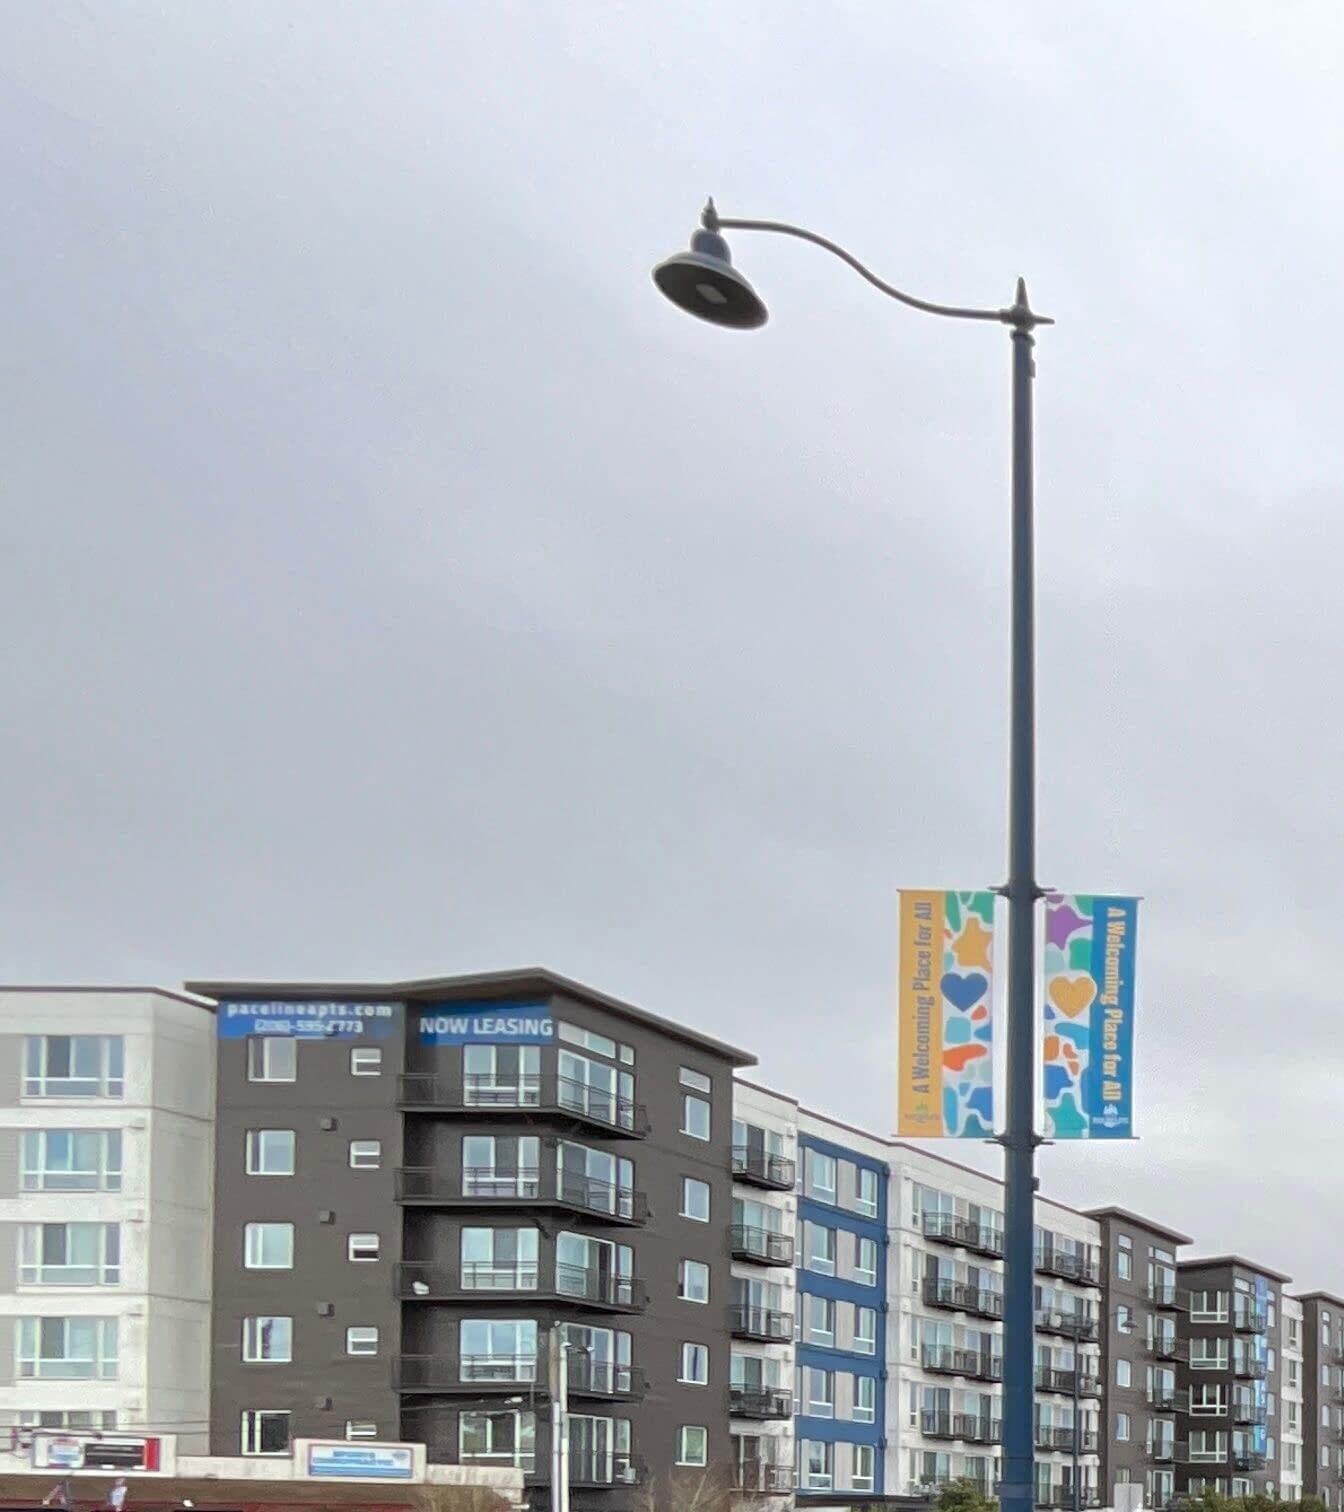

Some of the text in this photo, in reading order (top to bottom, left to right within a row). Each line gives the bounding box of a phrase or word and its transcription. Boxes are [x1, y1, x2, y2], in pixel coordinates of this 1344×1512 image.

[914, 902, 932, 920] All
[1107, 907, 1127, 918] A
[914, 925, 932, 948] for
[912, 951, 932, 991] Place
[1101, 921, 1125, 1005] Welcoming
[227, 1003, 392, 1018] pacelineapts.com
[420, 1017, 553, 1036] NOW LEASING
[1103, 1008, 1124, 1050] Place
[912, 996, 935, 1082] Welcoming
[1103, 1054, 1122, 1077] for
[912, 1084, 930, 1094] A
[1102, 1080, 1122, 1101] All
